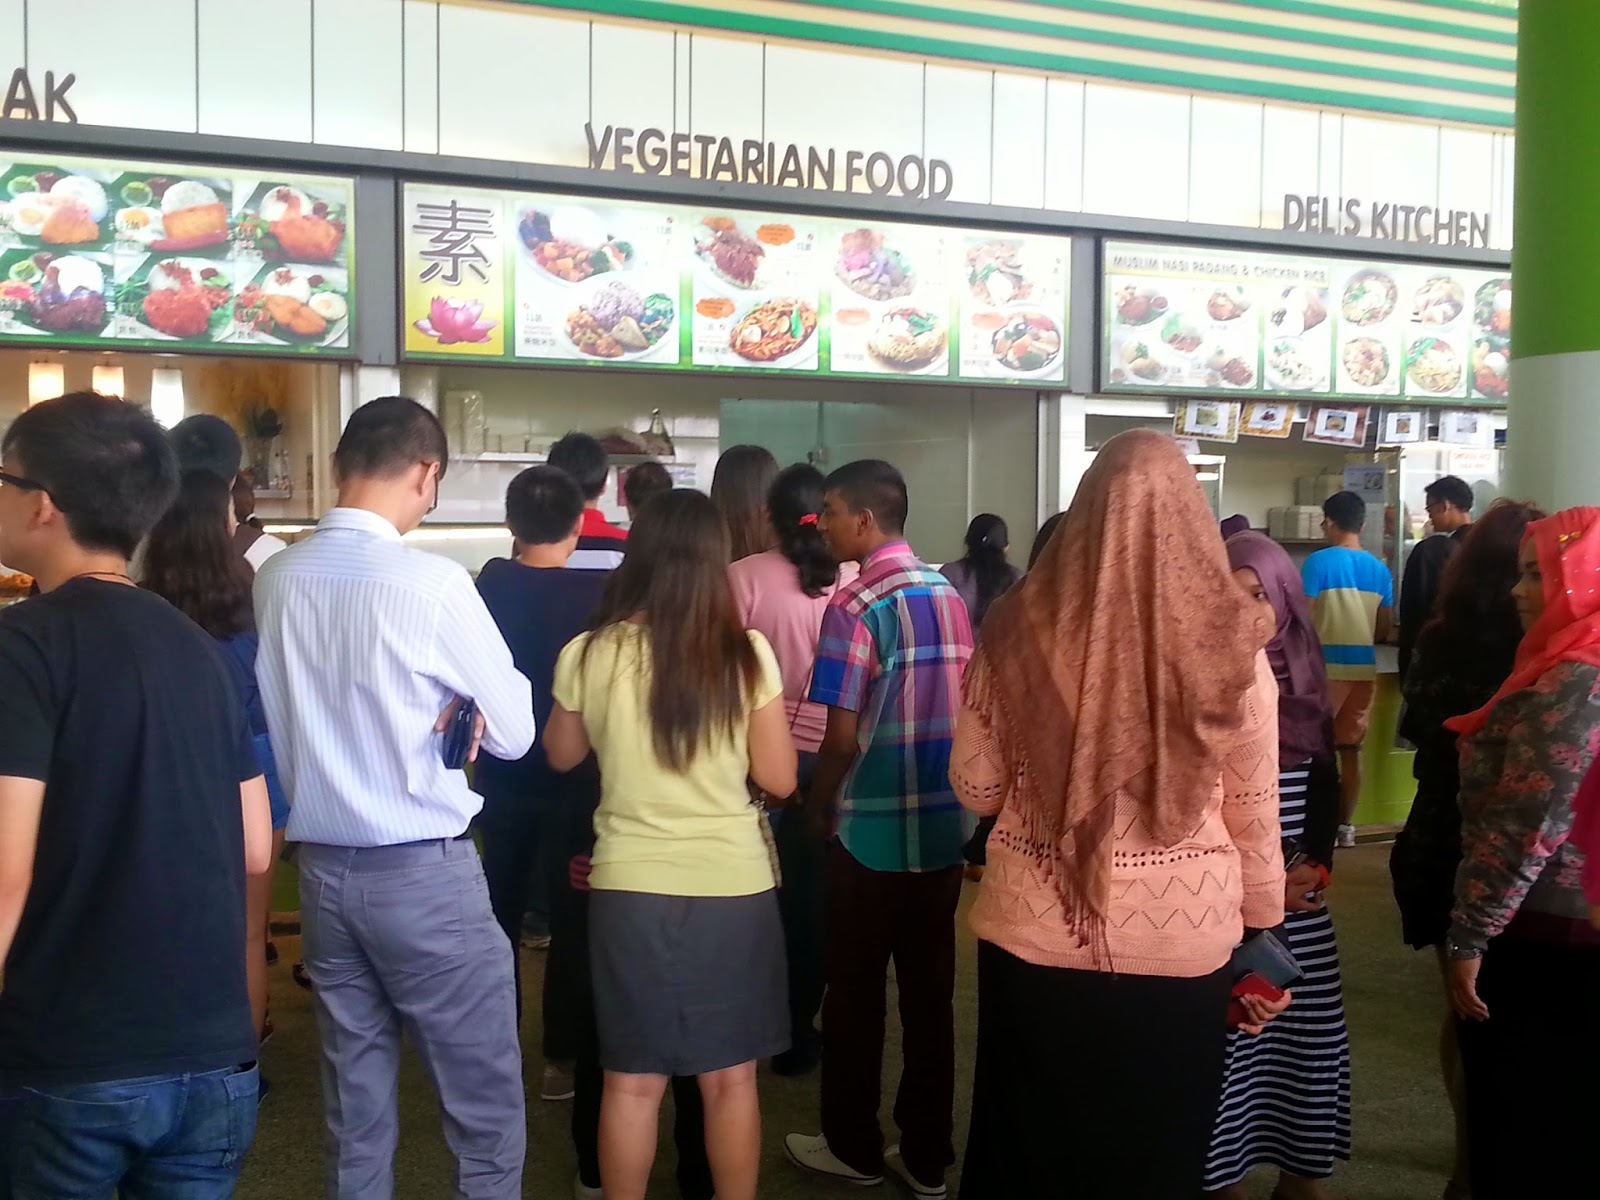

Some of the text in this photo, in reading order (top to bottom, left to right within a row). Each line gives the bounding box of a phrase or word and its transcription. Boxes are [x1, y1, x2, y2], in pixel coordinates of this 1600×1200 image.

[3, 68, 77, 124] AK
[585, 123, 953, 201] VEGETARIAN FOOD
[413, 200, 495, 285] 素
[1284, 194, 1490, 249] DEL'S KITCHEN
[1113, 255, 1160, 271] MUSLIM
[1162, 259, 1190, 272] NASI
[1192, 261, 1239, 276] PADANG
[1253, 266, 1301, 281] CHICKEN
[1303, 270, 1327, 282] RICE
